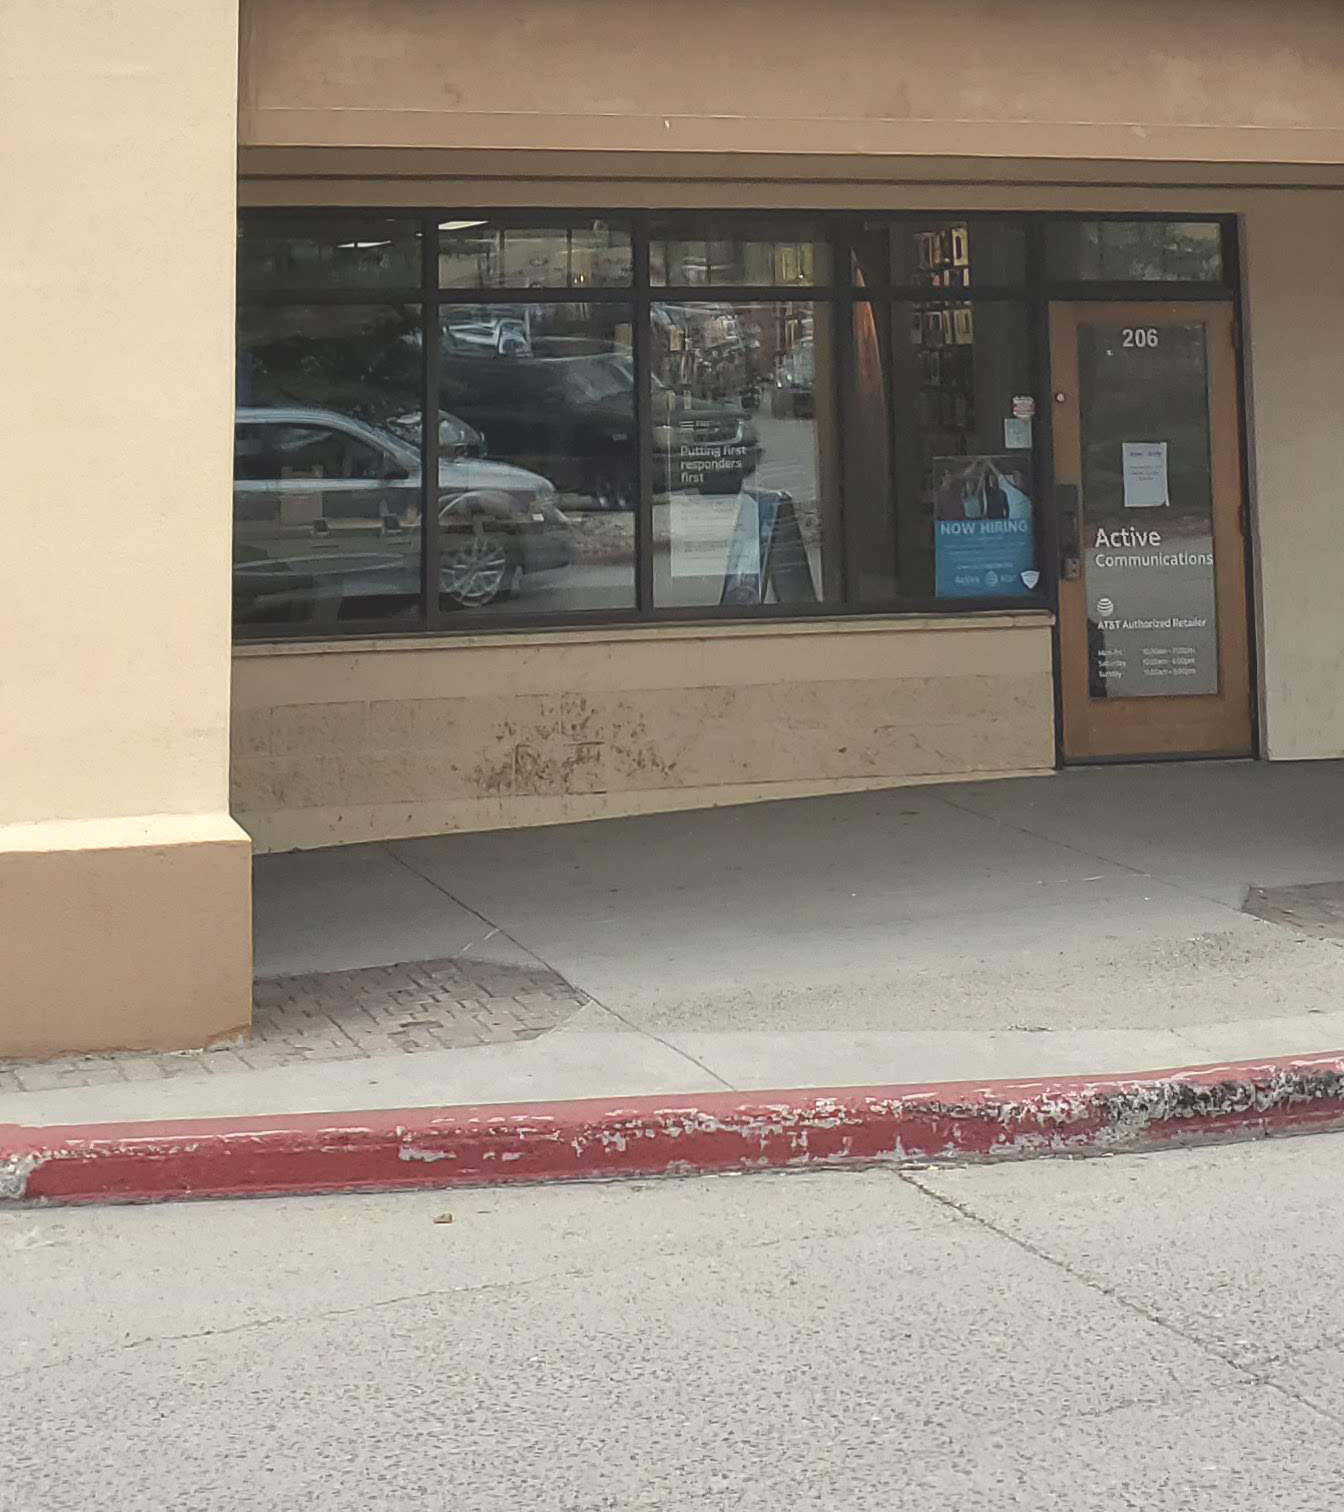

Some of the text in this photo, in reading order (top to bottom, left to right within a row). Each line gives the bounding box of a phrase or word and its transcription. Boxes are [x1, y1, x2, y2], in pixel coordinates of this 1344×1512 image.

[1122, 329, 1159, 347] 206
[681, 445, 746, 457] Putting first
[681, 458, 742, 472] responders
[681, 472, 704, 483] first
[940, 519, 1028, 536] NOW HIRING
[1095, 526, 1161, 548] Active
[1095, 552, 1214, 568] Communications
[1097, 616, 1207, 630] AT&T Authorized Retailer
